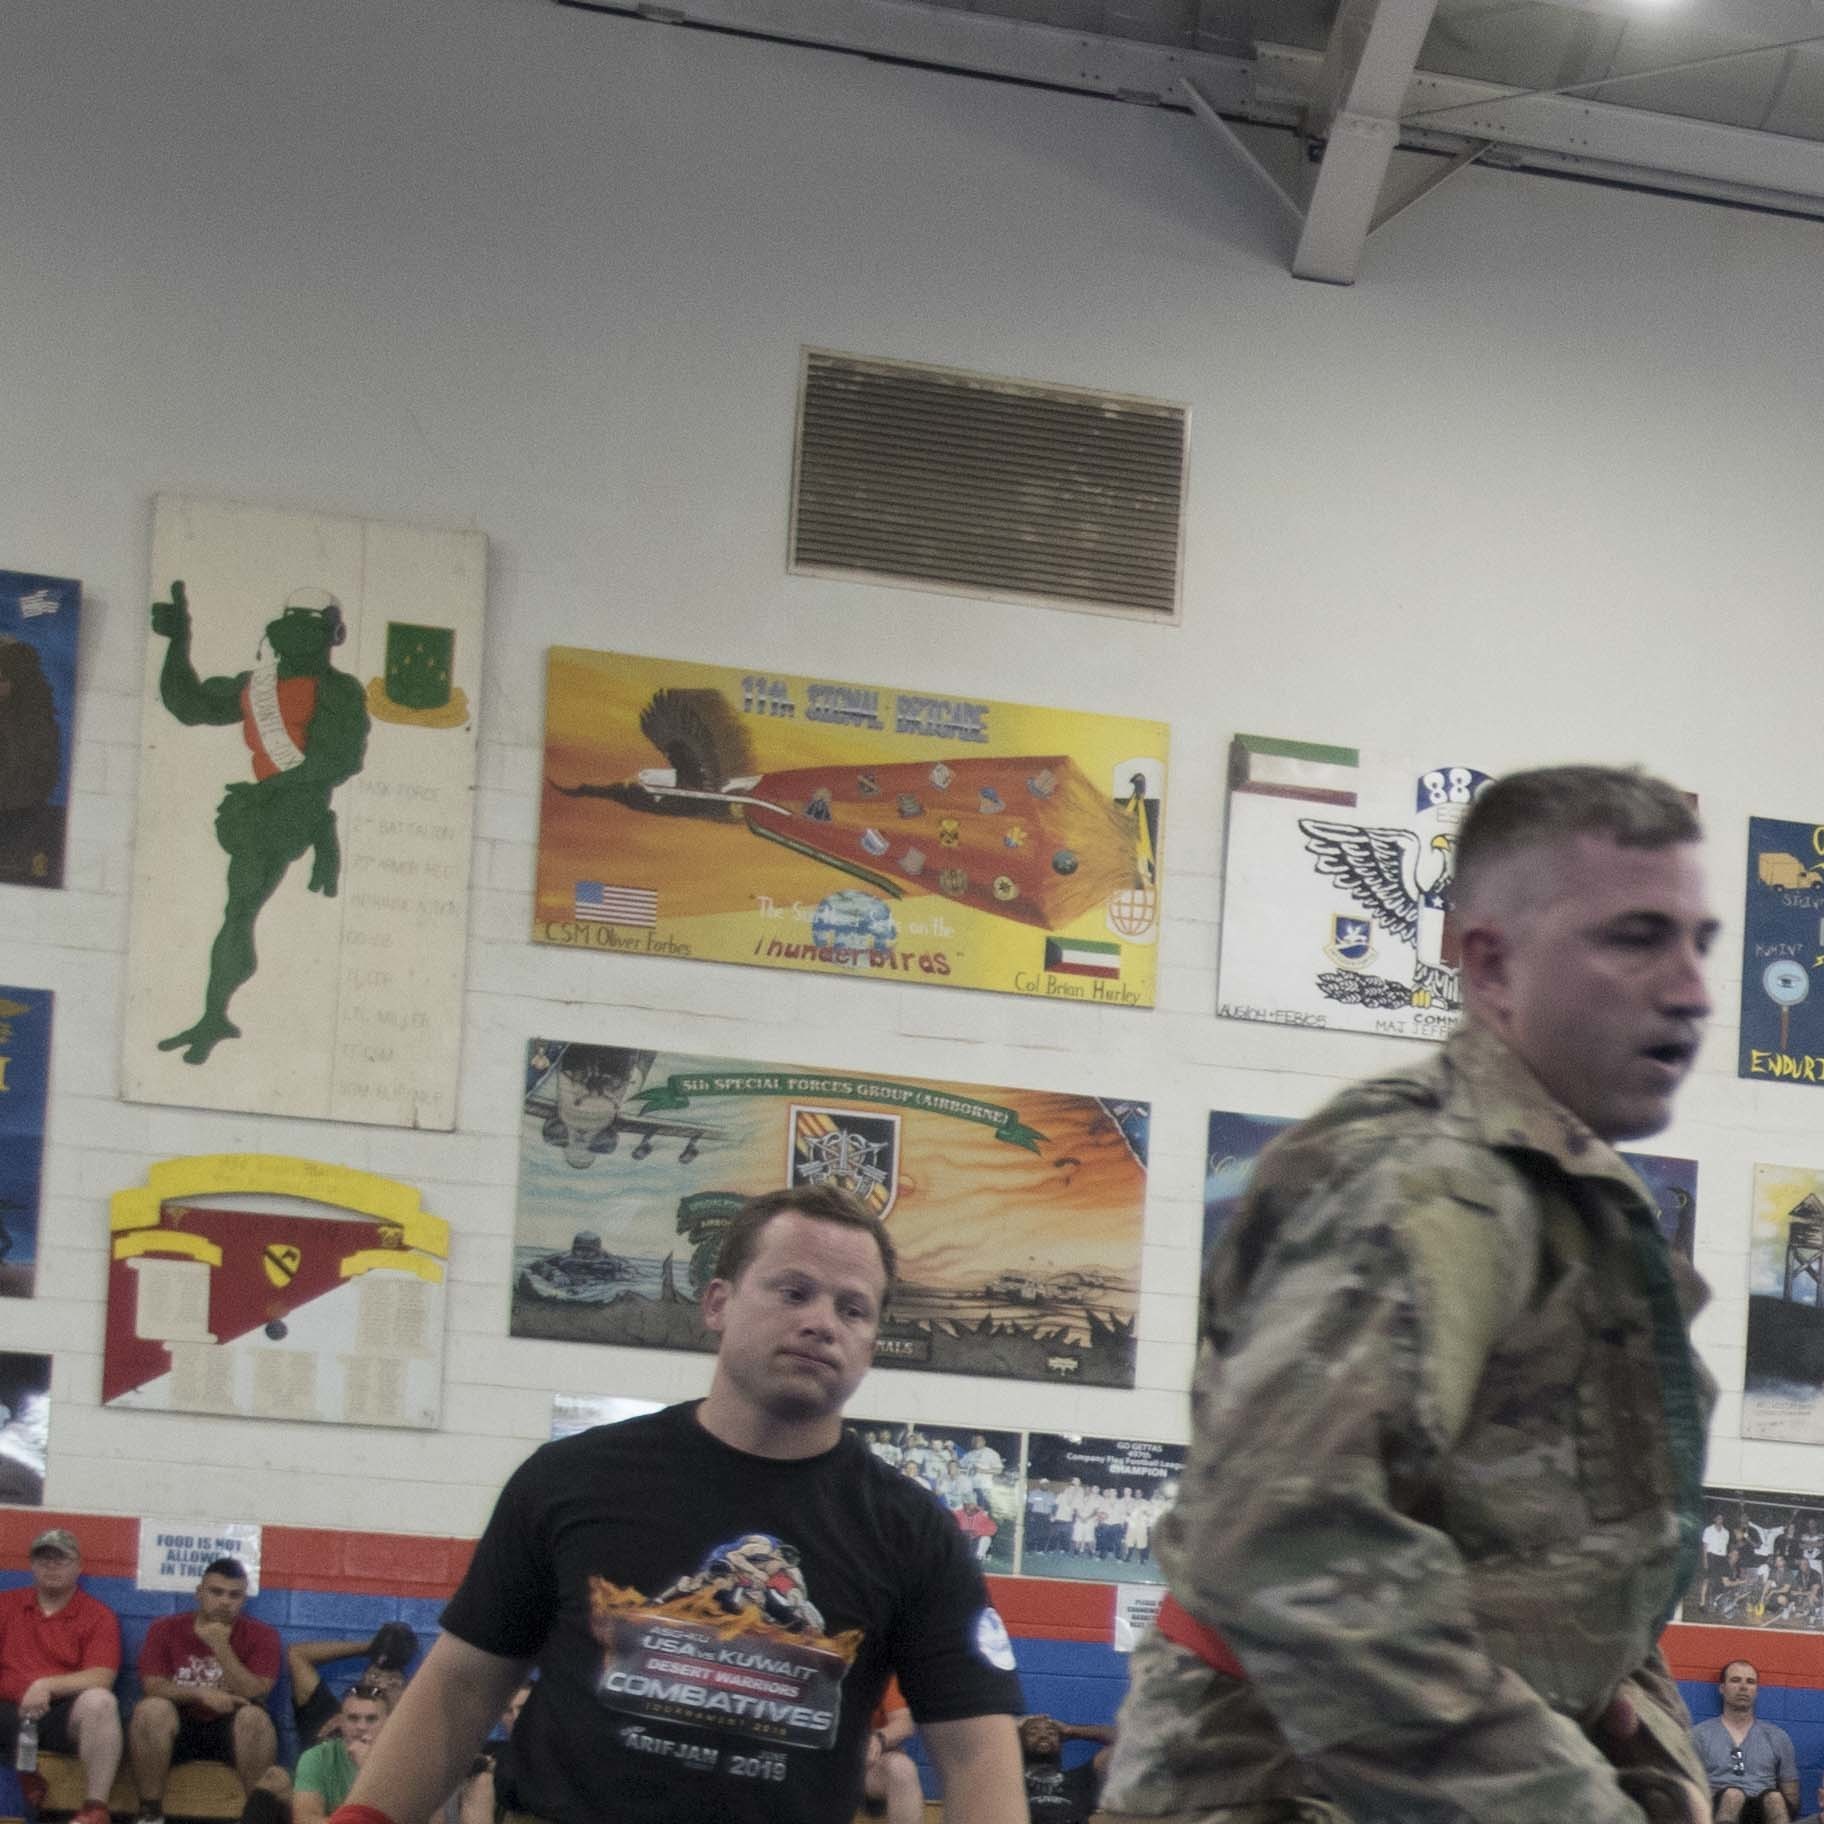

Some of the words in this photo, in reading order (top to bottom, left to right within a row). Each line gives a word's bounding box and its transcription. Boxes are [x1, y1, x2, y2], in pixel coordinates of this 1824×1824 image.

[545, 922, 590, 945] CSM
[647, 930, 690, 956] Forbes
[1014, 971, 1041, 994] Col
[1045, 977, 1085, 1000] Brian
[683, 1077, 710, 1092] 5th
[716, 1077, 781, 1091] SPECIAL
[788, 1077, 853, 1095] FORCES
[857, 1082, 914, 1102] GROUP
[916, 1089, 1010, 1126] (AIRBORNE)
[1109, 1463, 1168, 1478] CHAMPION
[157, 1534, 194, 1549] FOOD
[198, 1536, 212, 1550] IS
[642, 1635, 698, 1657] USA
[718, 1649, 819, 1681] KUWAIT
[647, 1658, 713, 1680] DESERT
[714, 1671, 800, 1698] WARRIORS
[604, 1671, 834, 1731] COMBATIVES
[645, 1702, 746, 1727] TOURNAMENT
[624, 1732, 720, 1765] ARIFJAN
[728, 1754, 787, 1782] 2019
